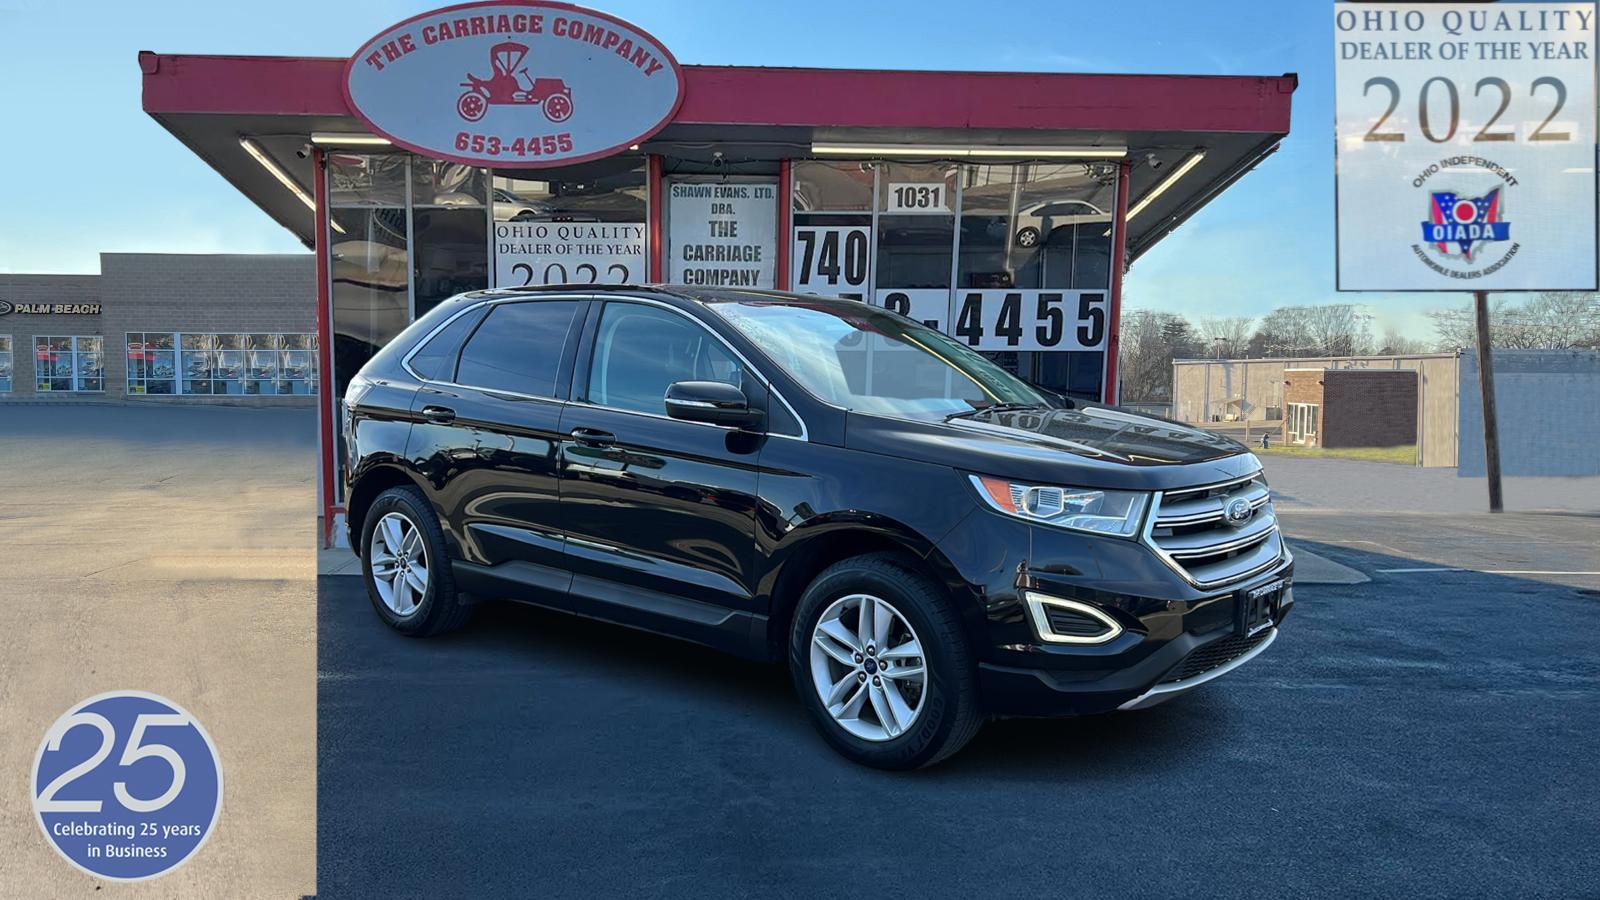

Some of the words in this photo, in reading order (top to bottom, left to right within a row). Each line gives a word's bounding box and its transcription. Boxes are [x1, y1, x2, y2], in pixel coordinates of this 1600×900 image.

[1336, 10, 1425, 31] OHIO
[1442, 10, 1593, 35] QUALITY
[366, 33, 415, 72] THE
[422, 14, 543, 45] CARRIAGE
[553, 17, 663, 77] COMPANY
[1340, 42, 1433, 60] DEALER
[1439, 41, 1469, 60] OF
[1475, 42, 1522, 60] THE
[1528, 42, 1589, 60] YEAR
[1363, 76, 1571, 143] 2022
[455, 132, 573, 157] 653-4455
[1412, 164, 1439, 188] OHIO
[1440, 156, 1519, 187] INDEPENDENT
[673, 186, 711, 198] SHAWN
[714, 187, 750, 199] EVANS.
[754, 187, 774, 199] LTD.
[895, 187, 940, 208] 1031
[711, 203, 736, 215] DBA.
[497, 226, 548, 238] OHIO
[558, 226, 644, 241] QUALITY
[709, 221, 737, 237] THE
[1432, 224, 1495, 240] OIADA
[500, 243, 552, 255] DEALER
[555, 243, 573, 255] OF
[576, 243, 603, 255] THE
[606, 243, 641, 255] YEAR
[683, 244, 762, 262] CARRIAGE
[798, 230, 868, 285] 740
[1411, 244, 1449, 277] AUTOMOBILE
[1450, 271, 1482, 279] DEALERS
[1483, 242, 1521, 276] ASSOCIATION
[683, 268, 760, 286] COMPANY
[14, 304, 51, 314] PALM
[54, 304, 100, 314] BEACH
